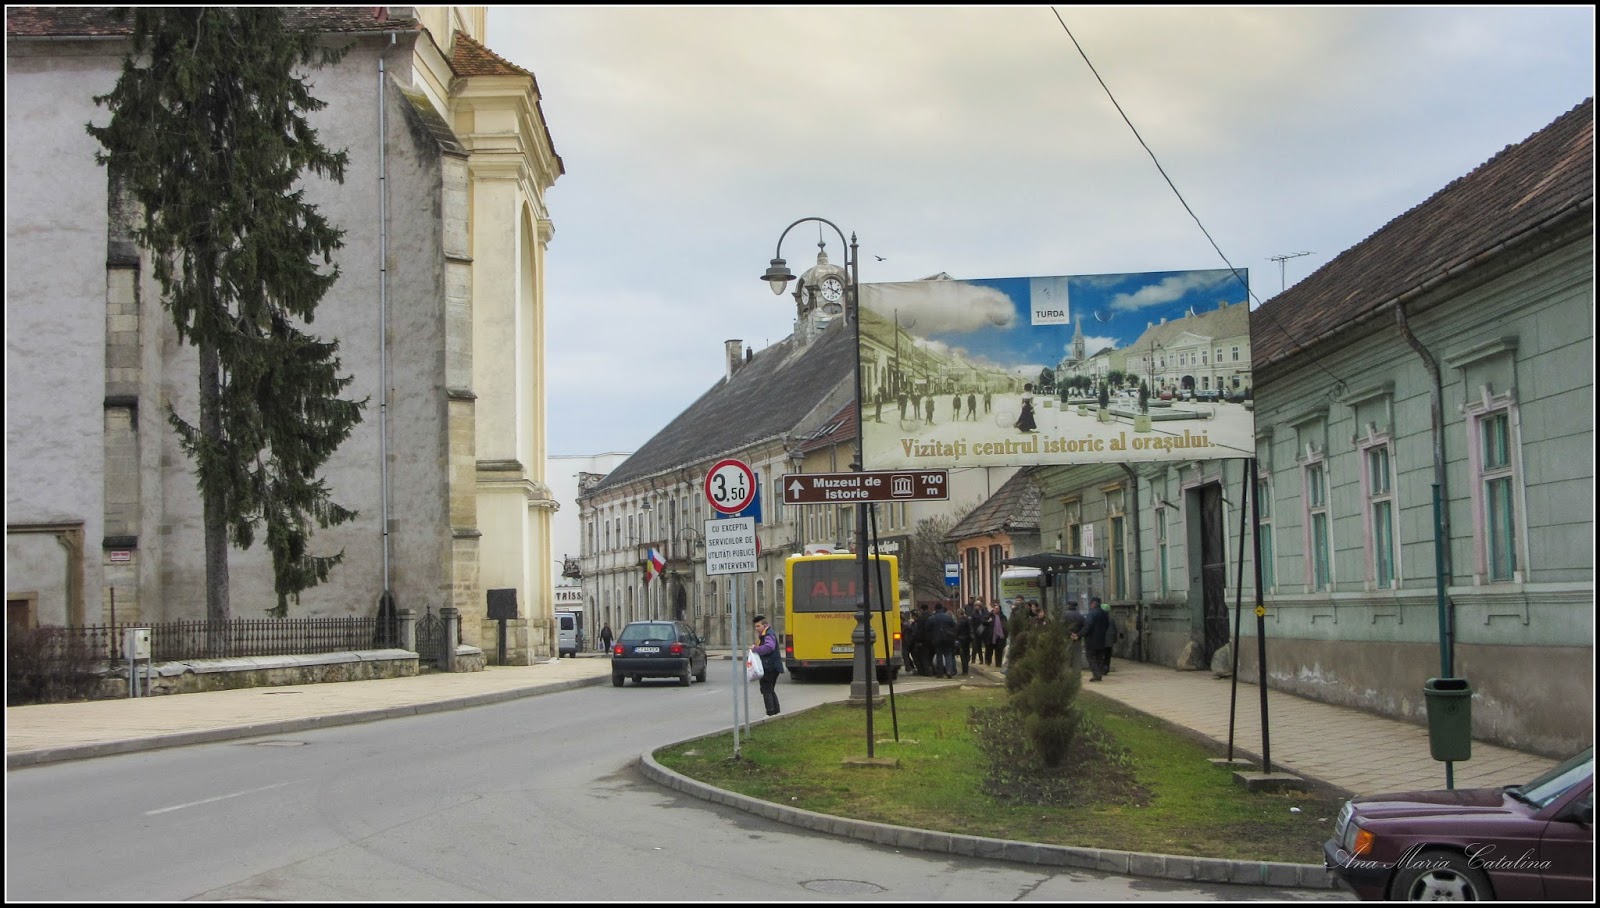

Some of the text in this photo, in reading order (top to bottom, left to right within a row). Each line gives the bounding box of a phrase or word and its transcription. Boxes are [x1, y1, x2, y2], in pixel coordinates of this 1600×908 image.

[1036, 310, 1065, 318] TURDA
[973, 435, 1039, 455] centrul
[1043, 434, 1104, 453] istoric
[1109, 431, 1127, 450] al
[813, 476, 882, 488] Muzeul de
[920, 474, 943, 485] 700
[825, 488, 869, 499] istorie
[926, 487, 939, 495] m
[711, 525, 720, 533] CU
[708, 535, 753, 546] SERVICIILOR DE
[732, 549, 755, 558] PUBLICE
